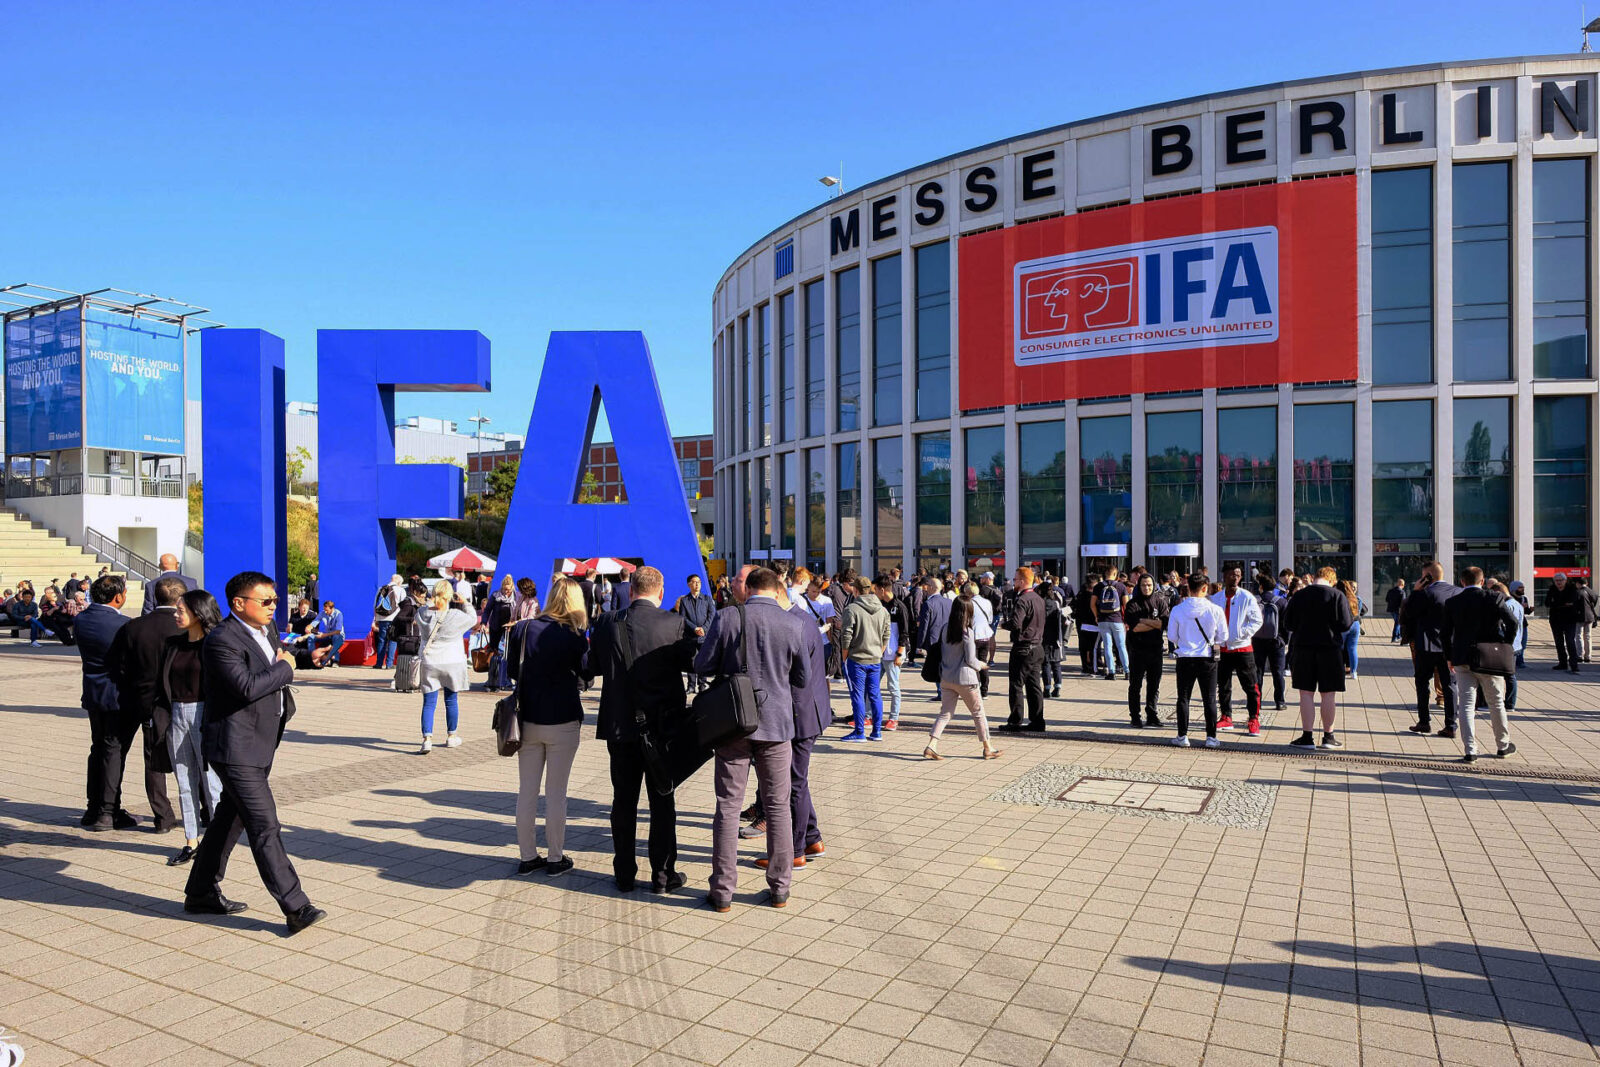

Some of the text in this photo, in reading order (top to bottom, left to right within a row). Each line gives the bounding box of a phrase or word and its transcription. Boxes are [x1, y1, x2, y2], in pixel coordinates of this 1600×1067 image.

[831, 79, 1589, 256] MESSE BERLIN
[1145, 241, 1272, 325] IFA
[1020, 320, 1273, 354] CONSUMER ELECTRONICS UNLIMITED
[7, 351, 80, 377] HOSTING THE WORLD.
[90, 349, 181, 373] HOSTING THE WORLD.
[111, 361, 163, 380] AND YOU.
[22, 367, 64, 391] AND YOU.
[200, 328, 711, 641] IFA
